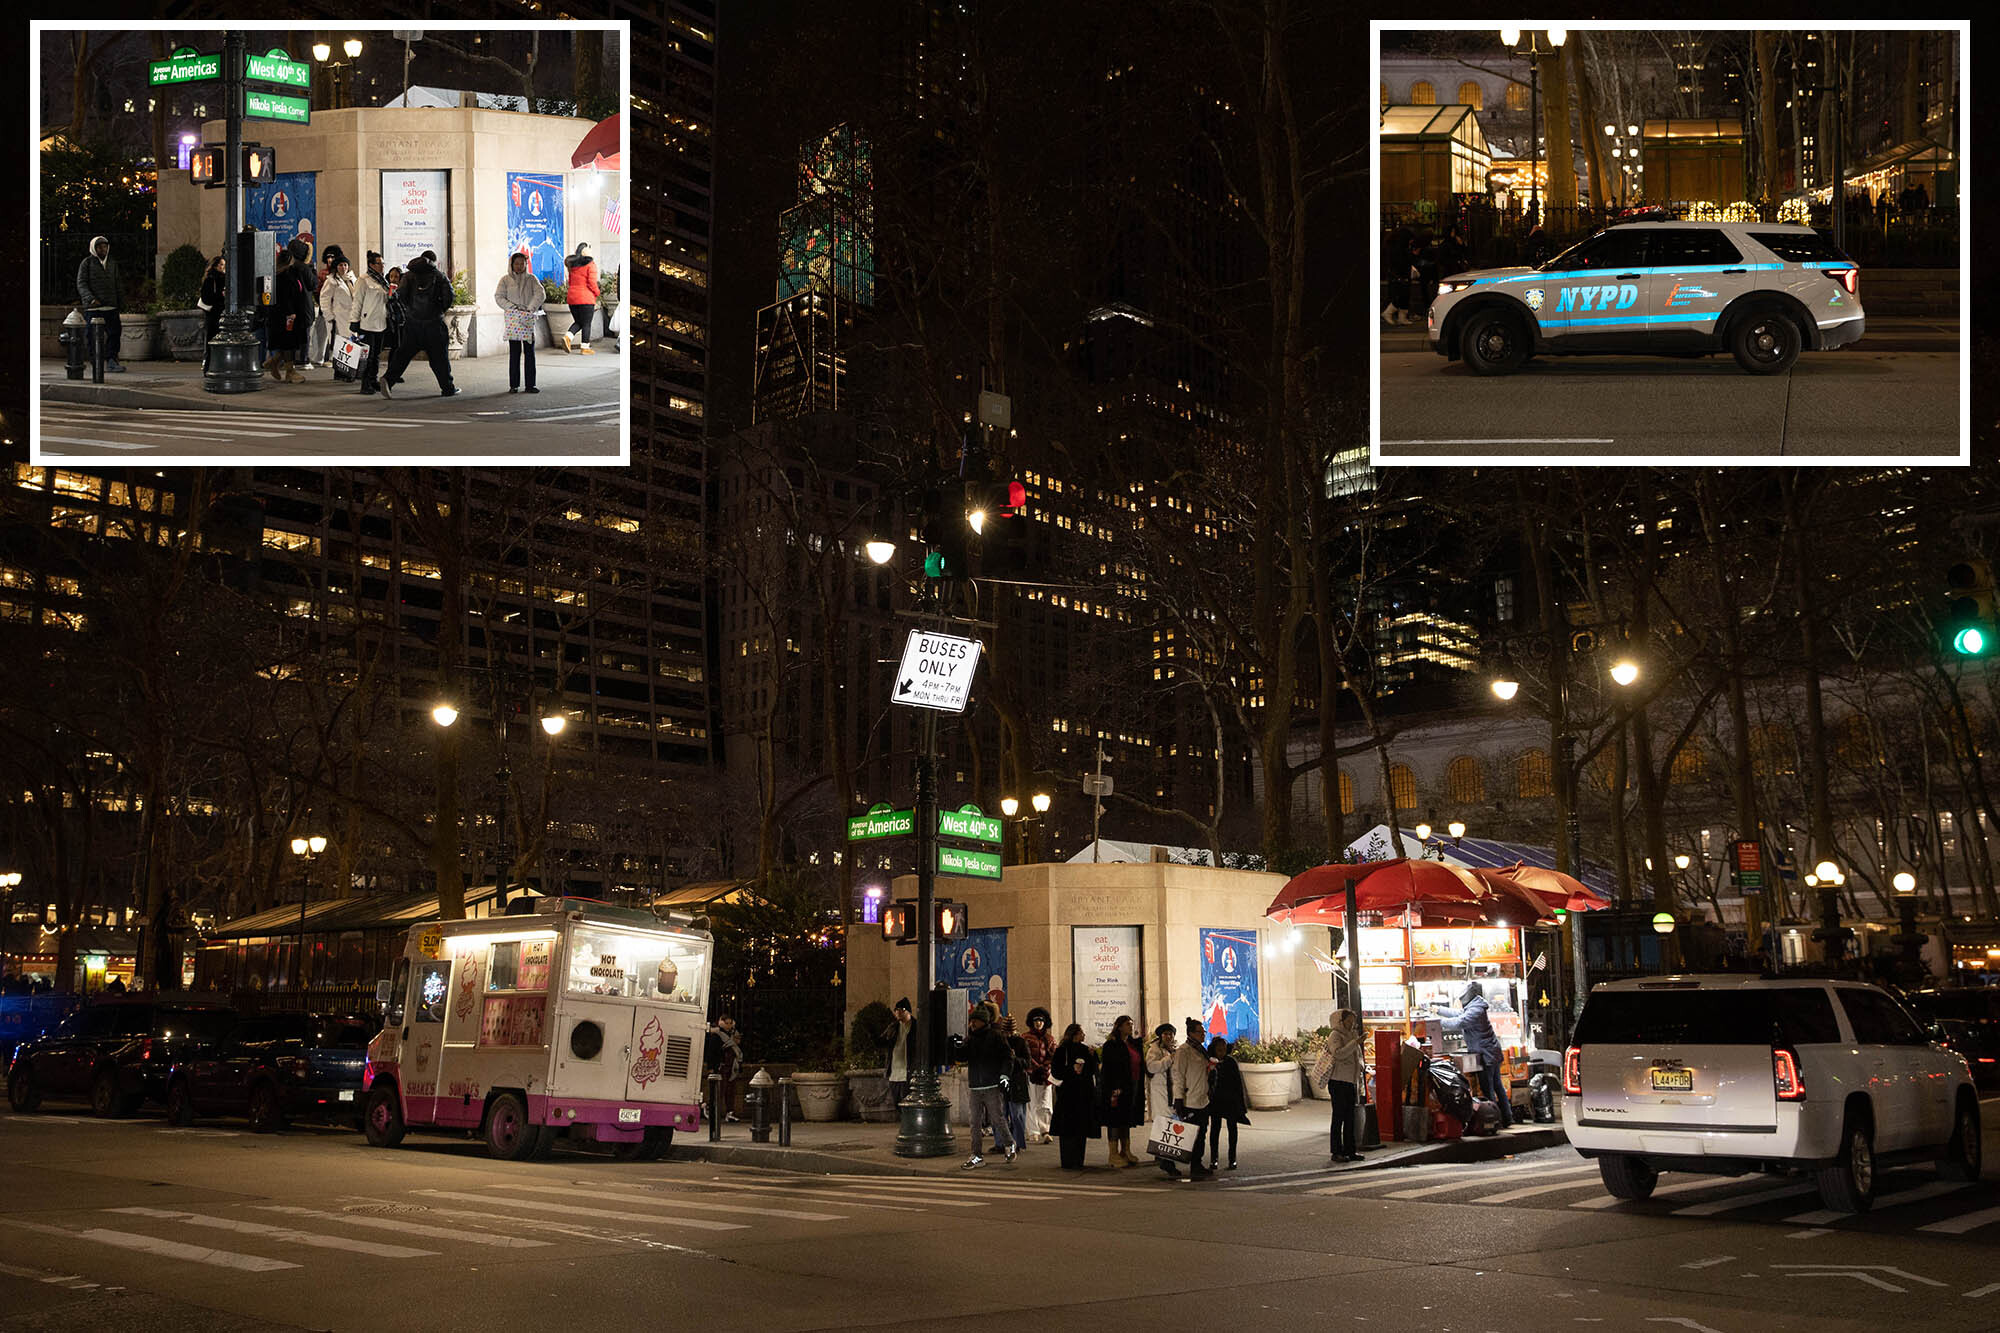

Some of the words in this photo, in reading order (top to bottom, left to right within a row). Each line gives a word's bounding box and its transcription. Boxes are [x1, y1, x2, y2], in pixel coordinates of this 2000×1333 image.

[170, 61, 217, 79] Americas
[250, 60, 275, 78] West
[276, 64, 294, 80] 40th
[296, 67, 307, 83] St
[153, 74, 159, 82] of
[159, 73, 168, 81] the
[249, 98, 270, 112] Nikola
[271, 101, 287, 114] Tesla
[288, 106, 305, 117] Corner
[408, 188, 427, 198] shop
[401, 197, 423, 206] skate
[407, 206, 427, 215] smile
[1555, 284, 1639, 312] NYPD
[337, 350, 351, 364] NY
[919, 638, 967, 660] BUSES
[918, 658, 958, 678] ONLY
[912, 690, 931, 700] MON
[932, 694, 949, 703] THRU
[950, 696, 963, 705] FRI
[867, 816, 911, 835] Americas
[943, 815, 968, 834] West
[969, 820, 987, 836] 40th
[988, 823, 999, 839] St
[942, 853, 963, 868] Nikola
[964, 857, 980, 870] Tesla
[980, 861, 998, 872] Corner
[1094, 936, 1108, 944] eat
[533, 943, 544, 952] HOT
[1099, 945, 1120, 954] shop
[601, 955, 616, 965] HOT
[1093, 954, 1115, 962] skate
[1099, 962, 1120, 971] smile
[590, 967, 624, 979] CHOCOLATE
[1652, 1059, 1683, 1067] GMC
[1165, 1121, 1173, 1132] I
[1160, 1131, 1184, 1147] NY
[1157, 1144, 1182, 1156] GIFTS
